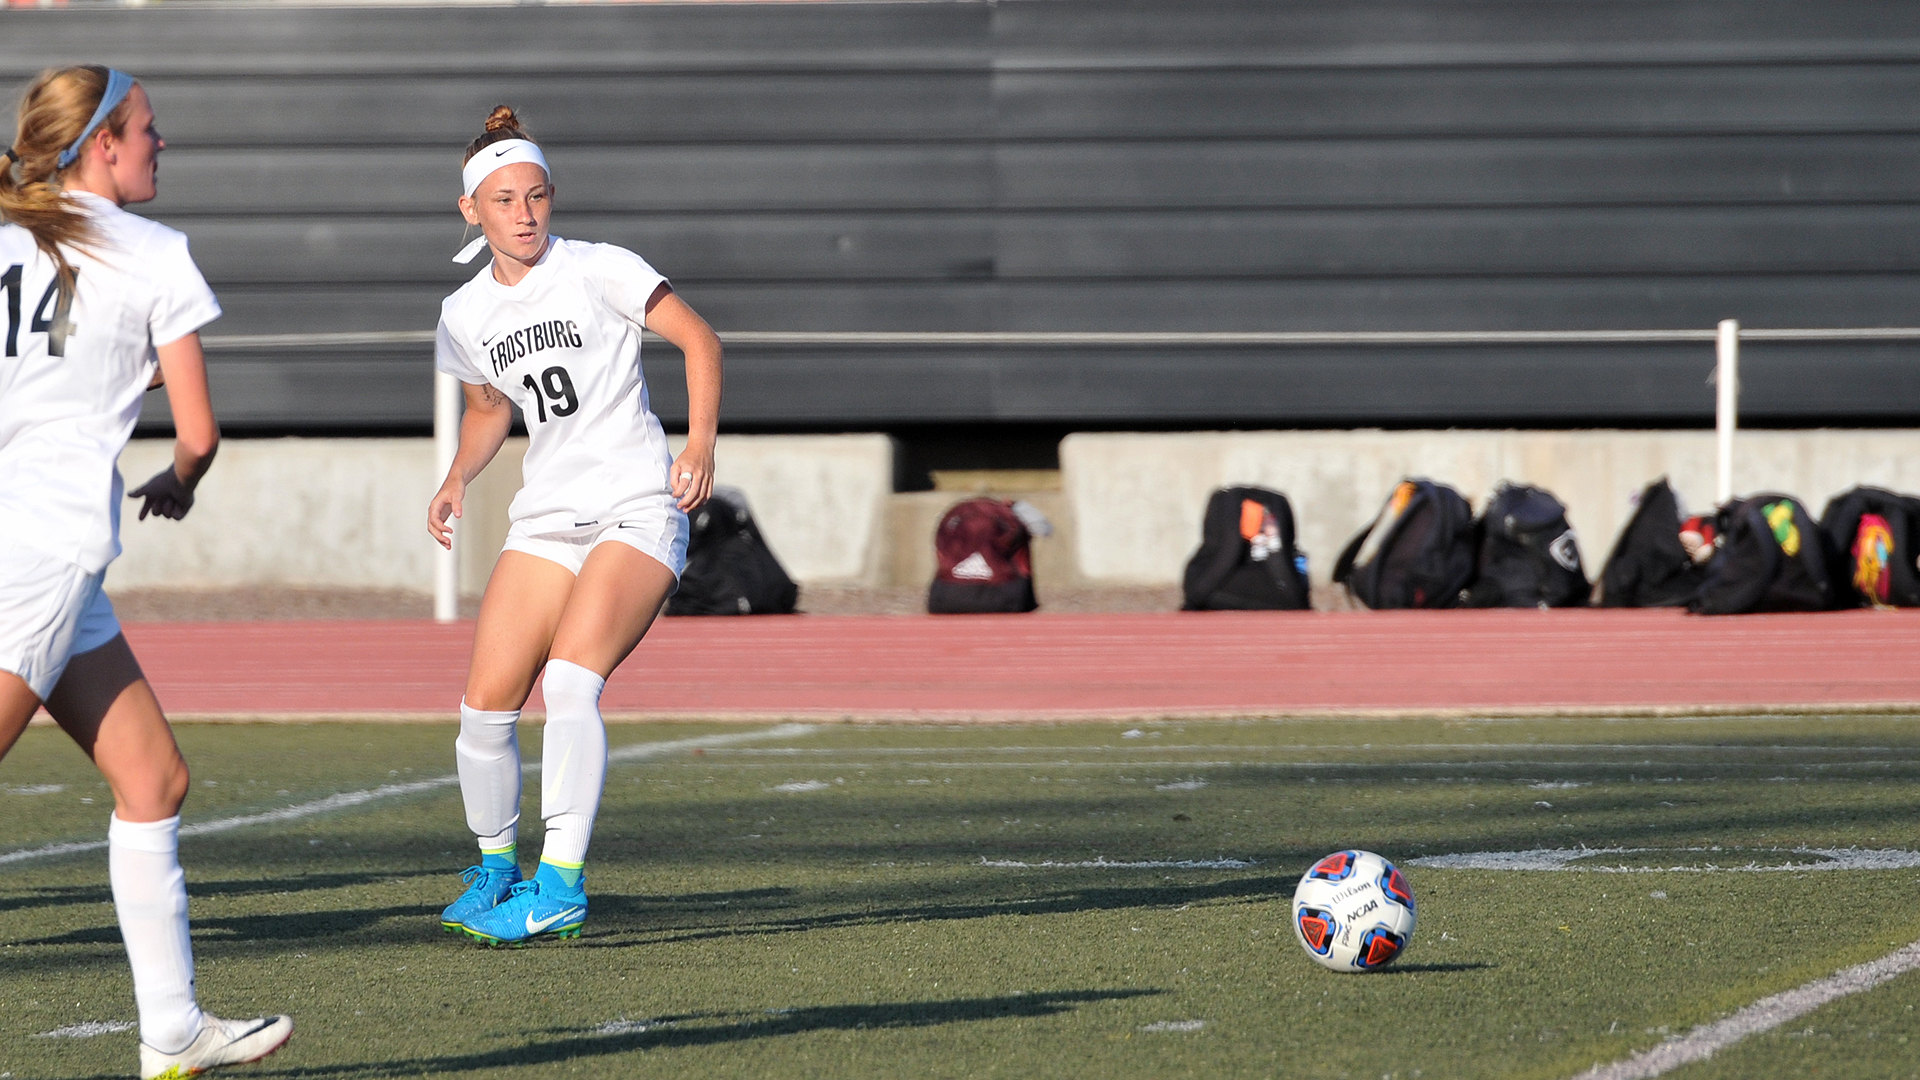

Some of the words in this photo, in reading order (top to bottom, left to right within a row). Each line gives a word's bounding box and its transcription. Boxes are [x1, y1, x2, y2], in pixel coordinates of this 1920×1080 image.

[0, 264, 81, 358] 14
[489, 320, 583, 378] FROSTBURG
[522, 366, 579, 423] 19
[1331, 881, 1372, 904] Wilson
[1346, 899, 1379, 923] NCAA
